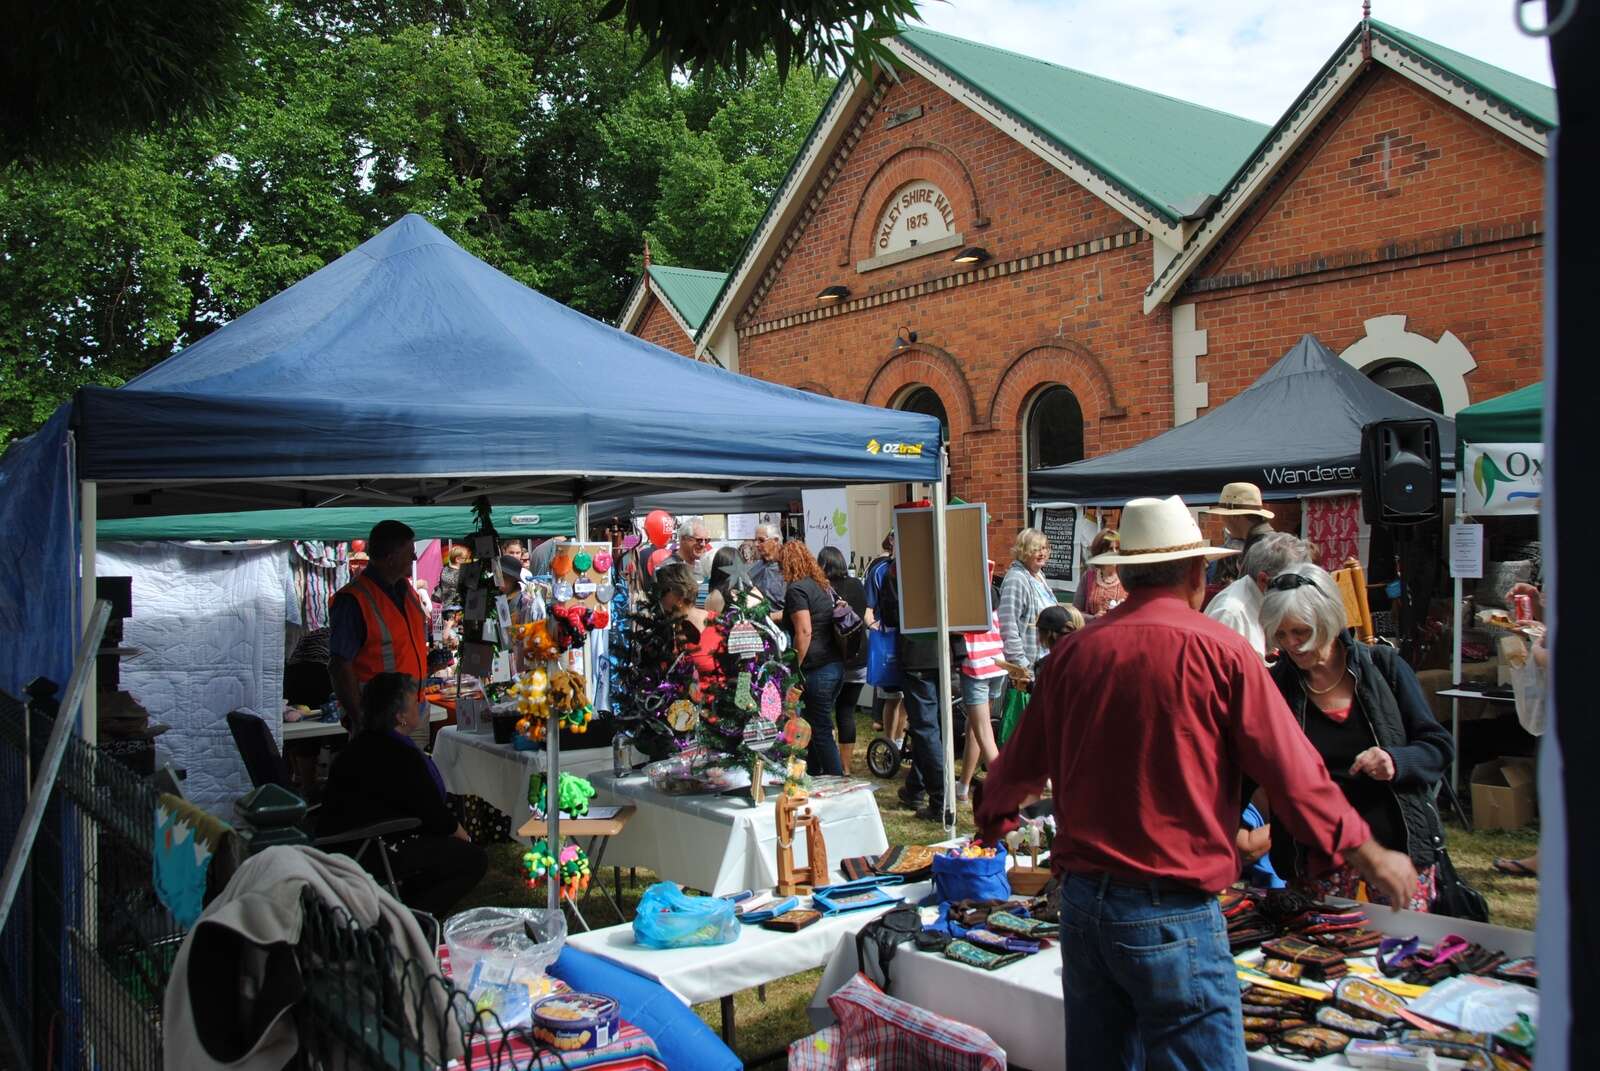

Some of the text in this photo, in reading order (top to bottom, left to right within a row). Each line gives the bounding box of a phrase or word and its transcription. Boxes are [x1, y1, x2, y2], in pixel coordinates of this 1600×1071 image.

[879, 188, 955, 249] OXLEY SHIRE HALL
[906, 212, 929, 232] 1875
[1263, 465, 1356, 485] Wanderer
